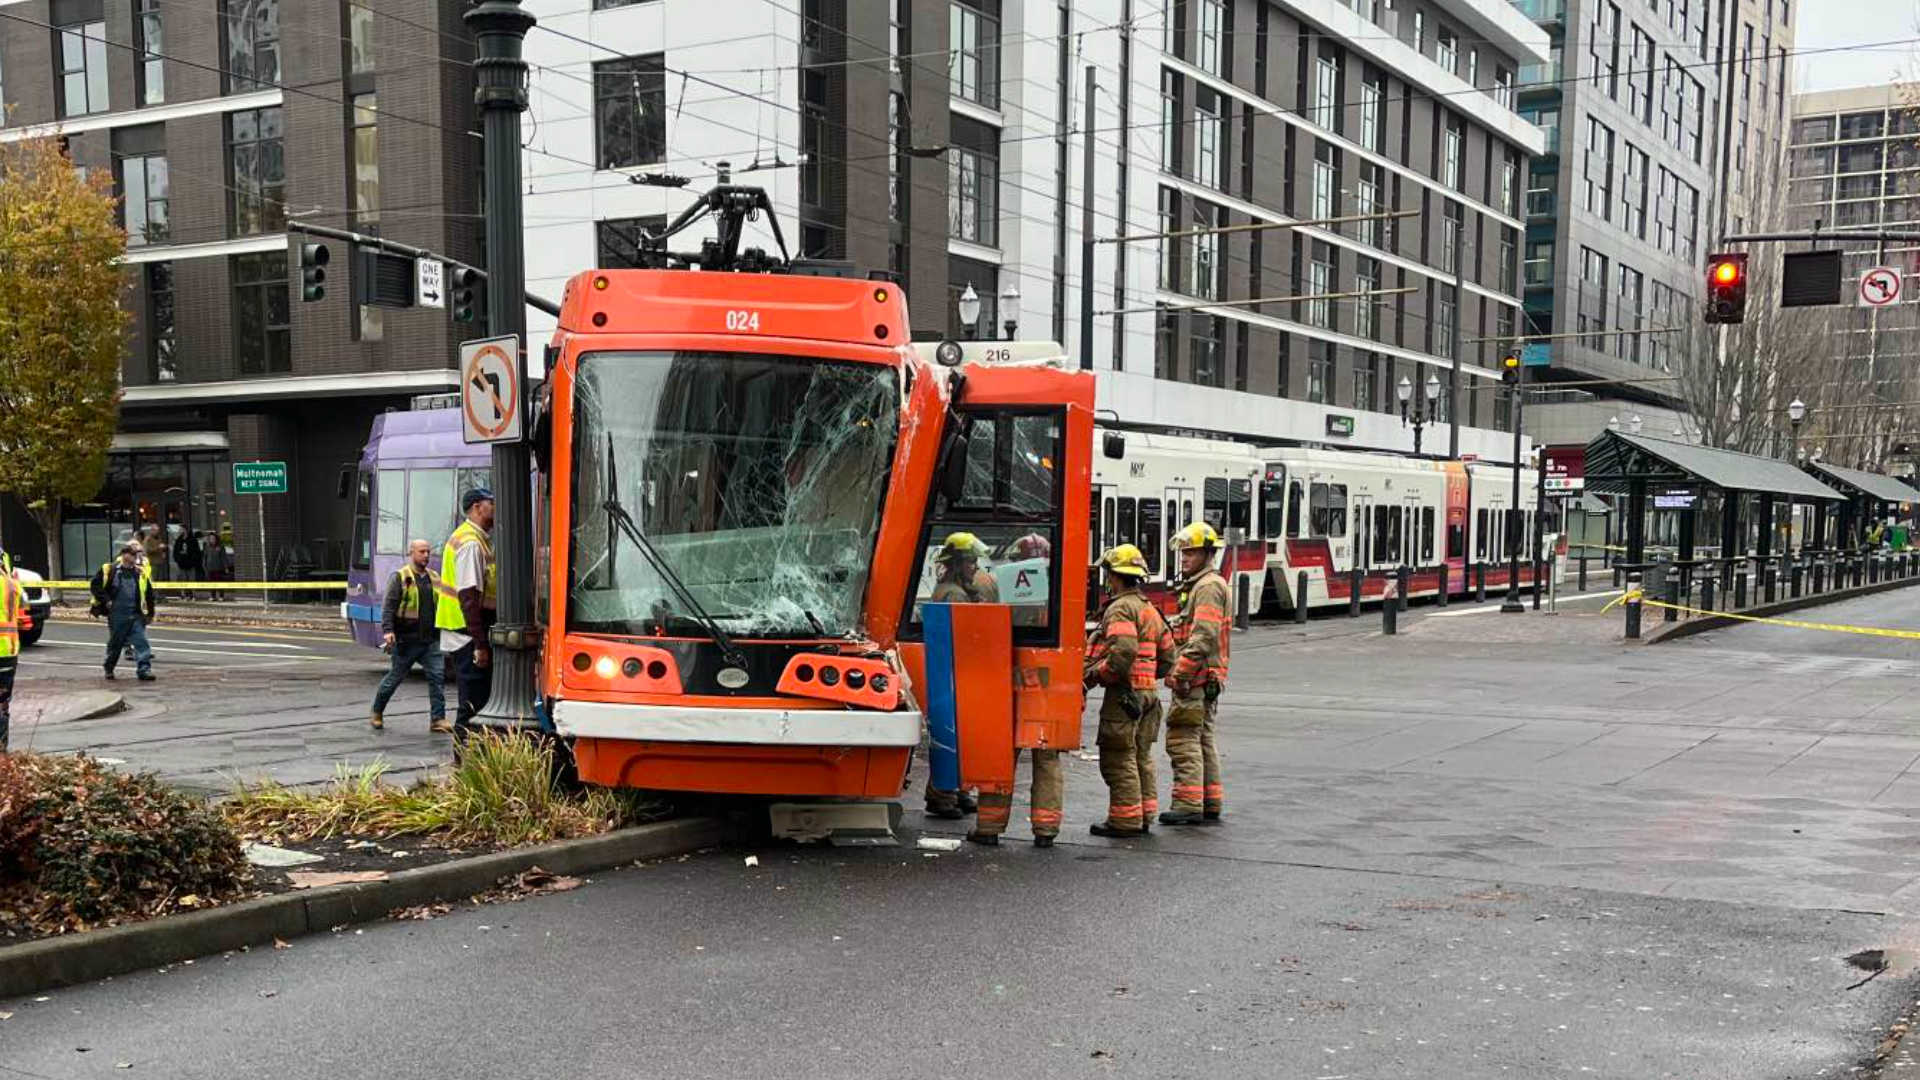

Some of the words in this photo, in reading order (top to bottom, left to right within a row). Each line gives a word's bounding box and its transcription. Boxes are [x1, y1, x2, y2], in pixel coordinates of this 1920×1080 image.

[422, 263, 439, 275] ONE
[422, 276, 439, 287] WAY
[726, 310, 760, 331] 024
[986, 349, 1010, 361] 216
[236, 468, 284, 478] Multnomah
[258, 479, 280, 487] SIGNAL
[1015, 570, 1031, 588] A
